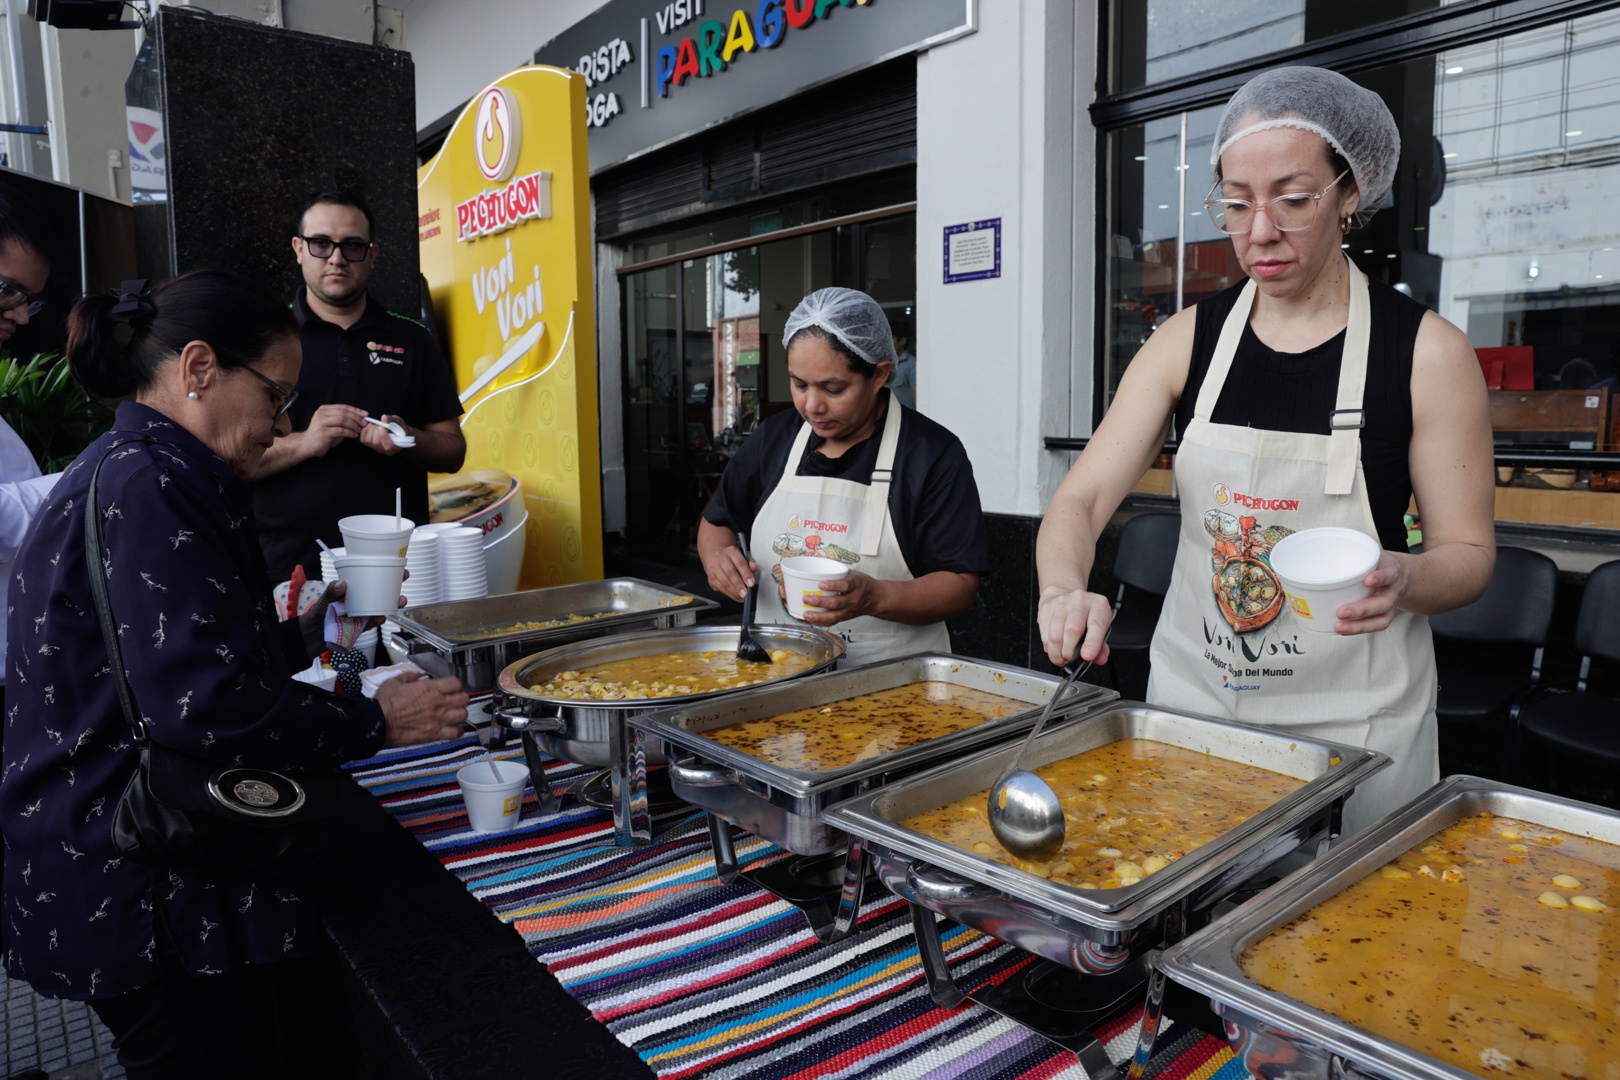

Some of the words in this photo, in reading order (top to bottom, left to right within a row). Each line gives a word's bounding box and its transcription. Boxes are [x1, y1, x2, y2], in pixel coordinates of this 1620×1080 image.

[657, 0, 868, 97] PARAGU
[456, 173, 541, 240] PECHUGON
[472, 237, 514, 315] Vori
[496, 264, 543, 342] Vori
[1204, 648, 1211, 660] La
[1211, 653, 1227, 670] Mejor
[1245, 668, 1260, 677] Del
[1262, 667, 1294, 677] Mundo
[1240, 634, 1306, 663] Vori
